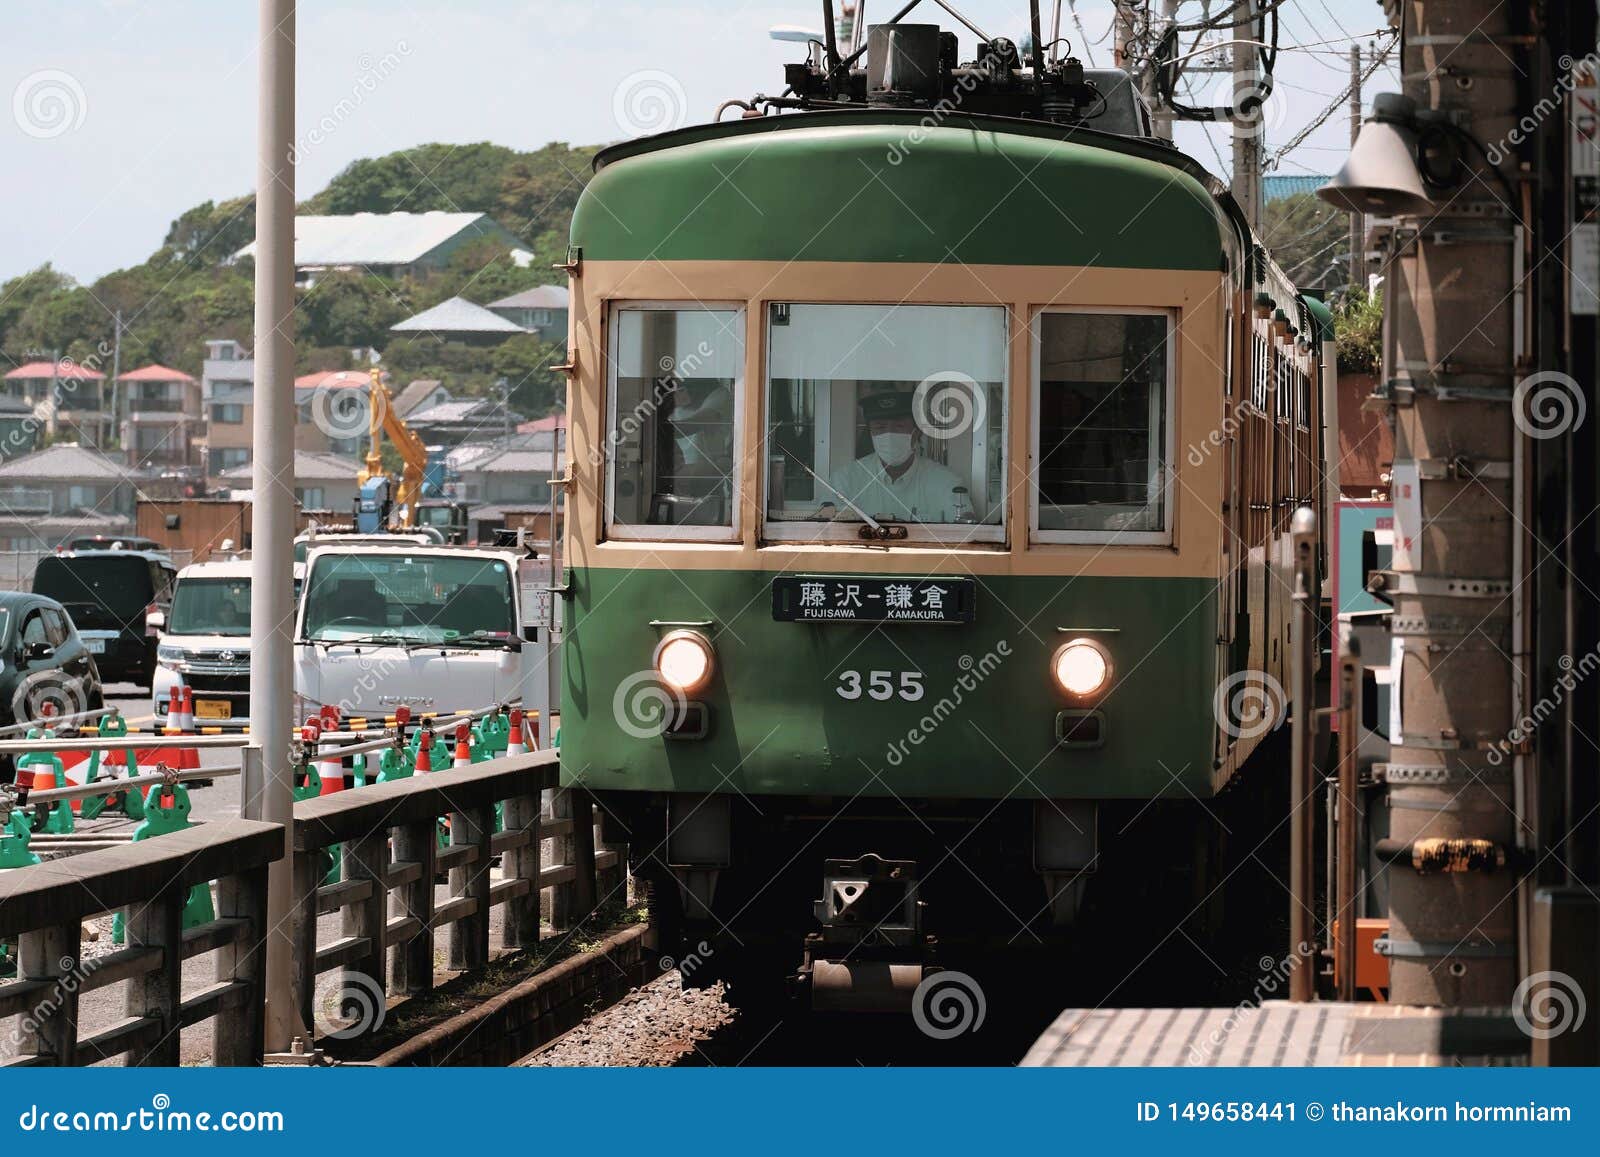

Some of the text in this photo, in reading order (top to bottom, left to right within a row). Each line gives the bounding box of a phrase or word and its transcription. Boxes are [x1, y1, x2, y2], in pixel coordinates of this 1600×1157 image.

[804, 608, 945, 620] FUJISAWA KAMAKURA
[836, 670, 925, 702] 355
